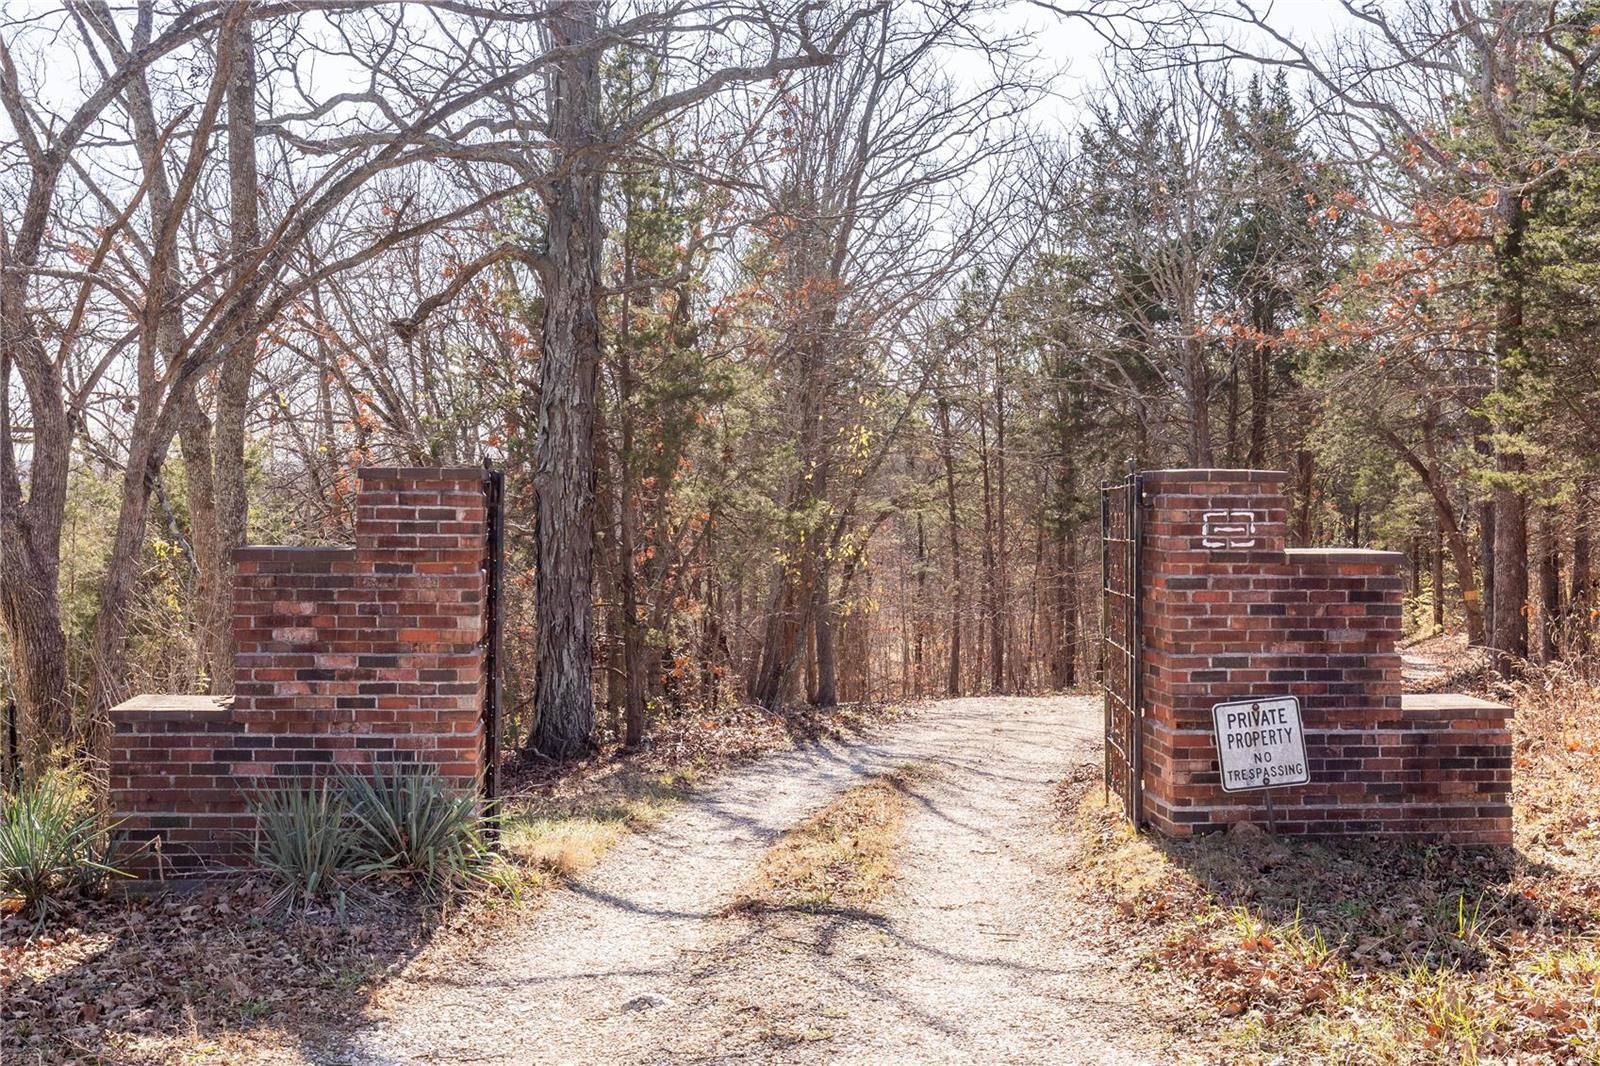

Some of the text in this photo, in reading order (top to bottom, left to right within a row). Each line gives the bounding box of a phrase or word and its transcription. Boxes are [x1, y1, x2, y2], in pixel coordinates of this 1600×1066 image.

[1227, 708, 1287, 729] PRIVATE
[1227, 727, 1292, 749] PROPERTY
[1253, 751, 1272, 764] NO
[1227, 763, 1303, 782] TRESPASSING
